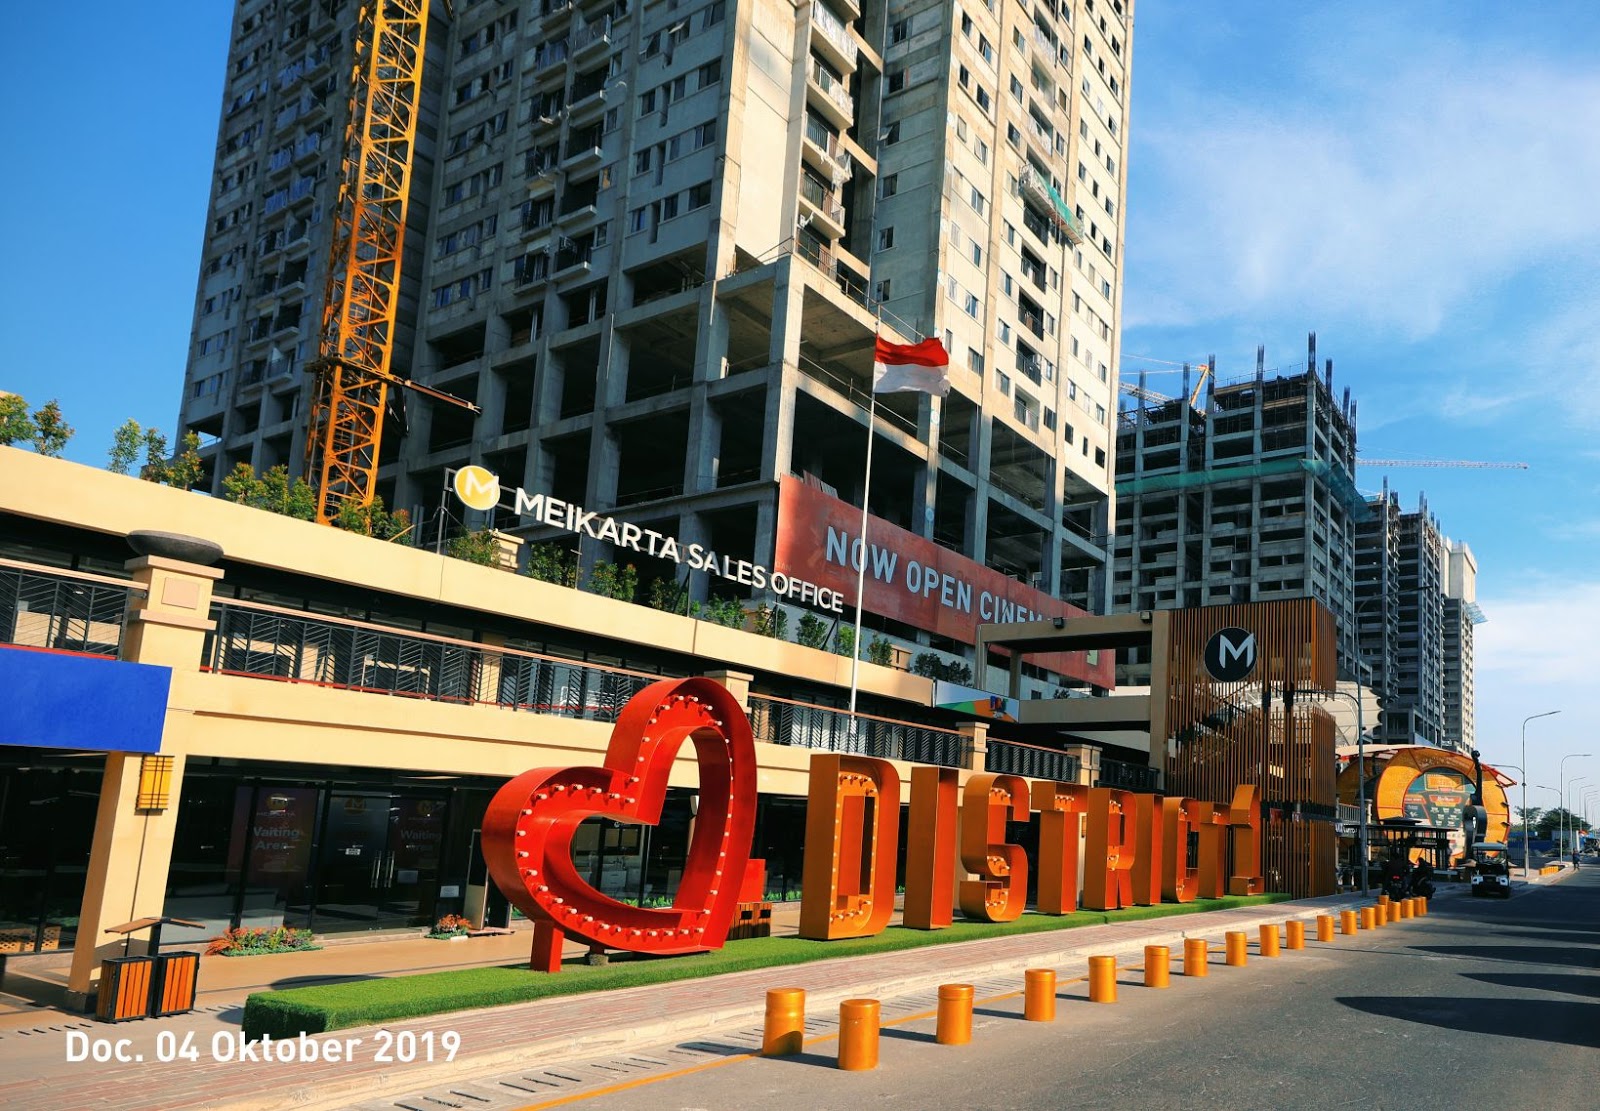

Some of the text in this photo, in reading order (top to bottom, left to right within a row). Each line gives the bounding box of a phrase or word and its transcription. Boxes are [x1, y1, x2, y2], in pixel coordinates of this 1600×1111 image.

[466, 467, 499, 503] M
[514, 488, 844, 614] MEIKARTA SALES OFFICE
[826, 525, 898, 584] NOW
[906, 560, 971, 614] OPEN
[1219, 632, 1254, 669] M
[799, 753, 1264, 940] DISTRICT 1
